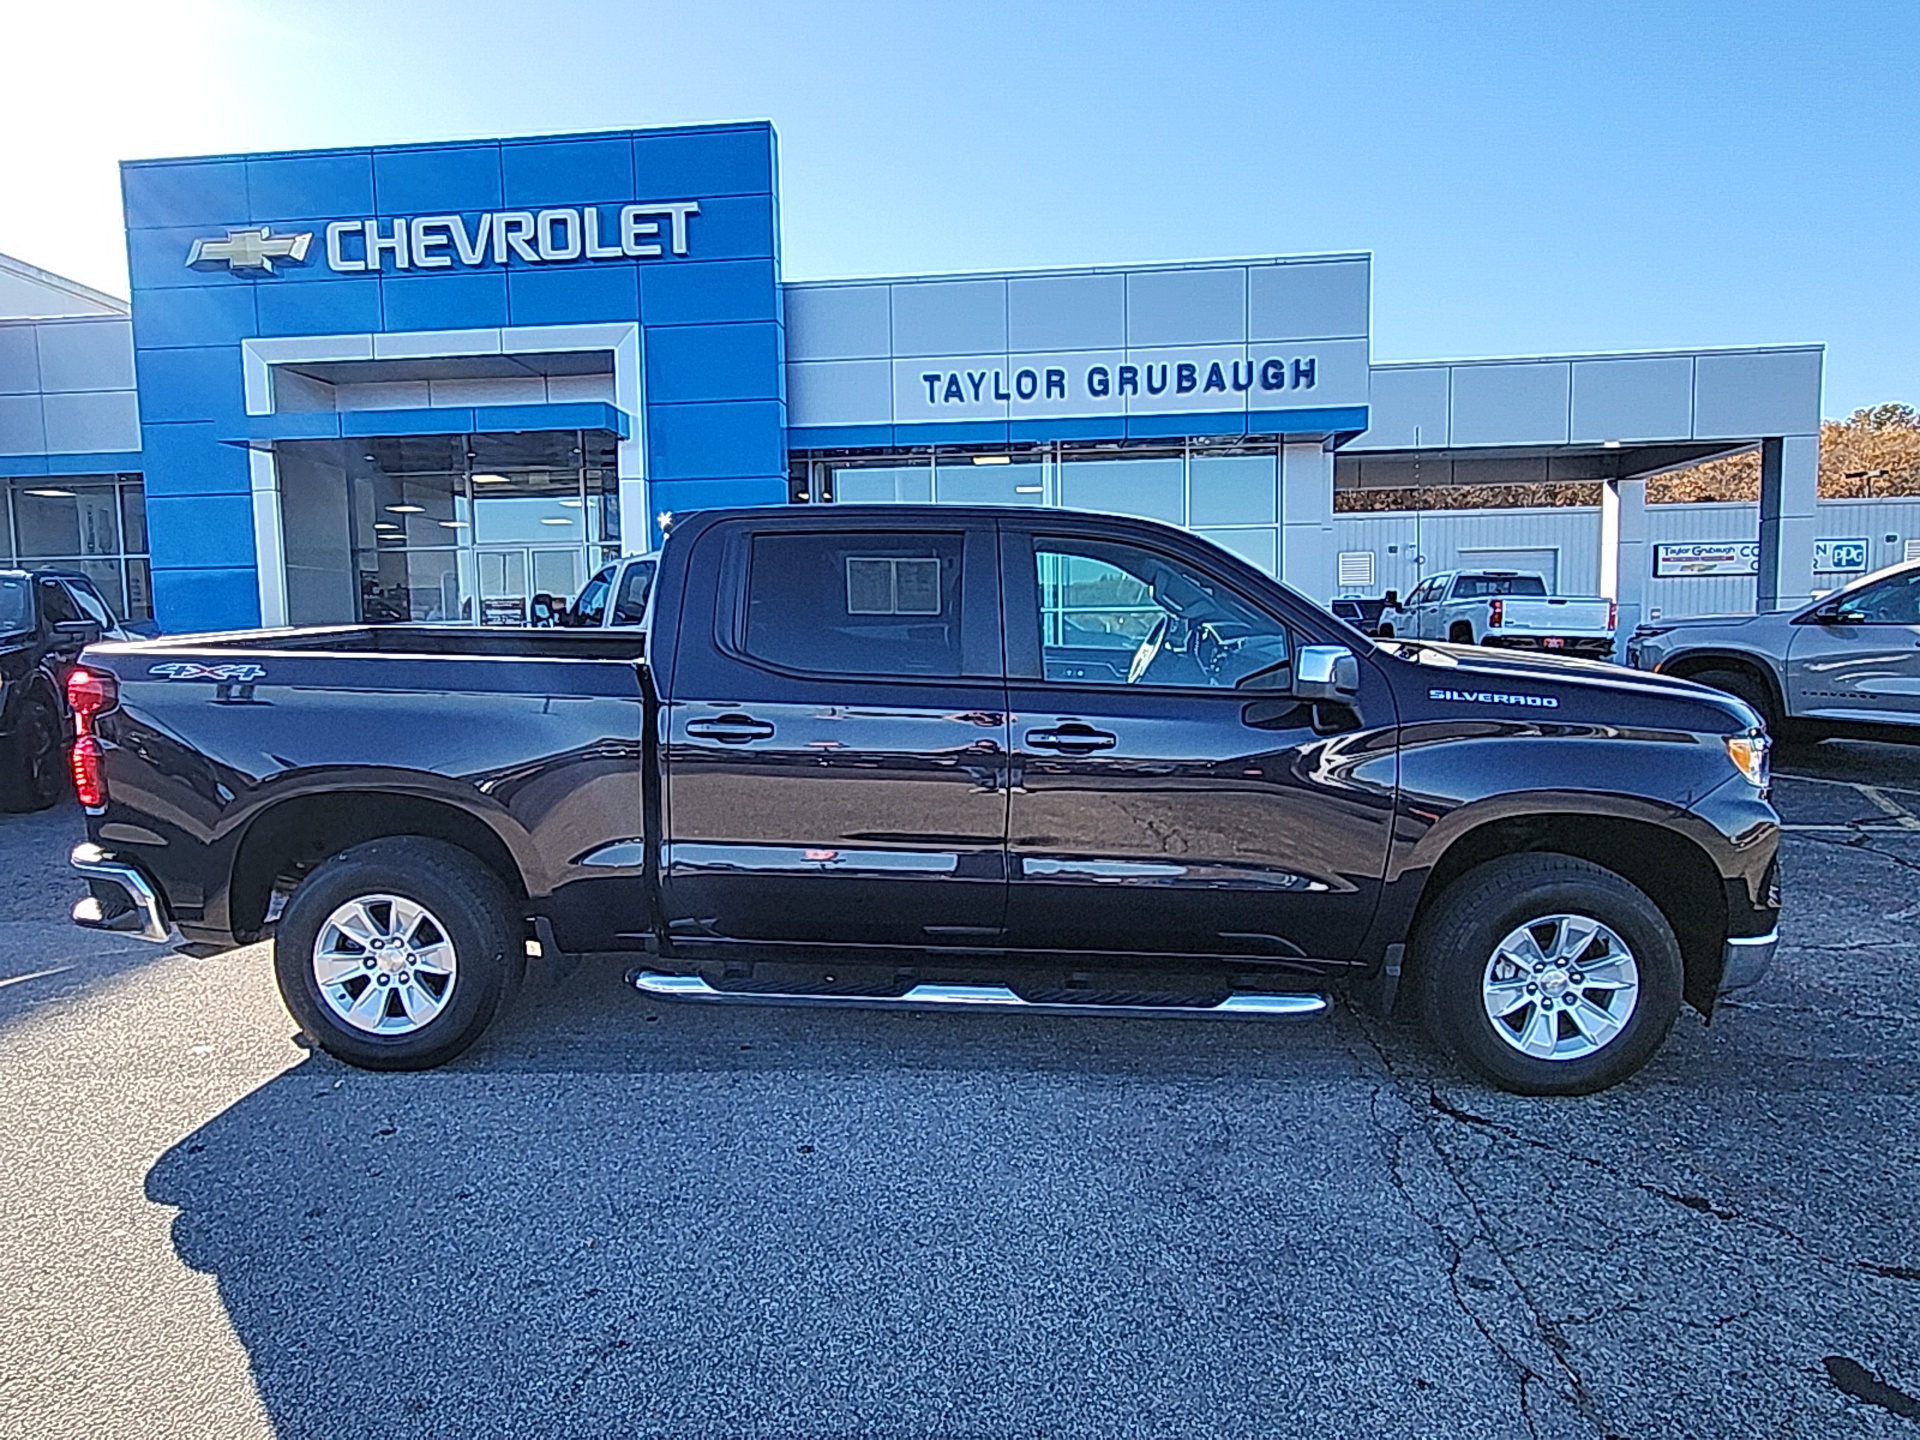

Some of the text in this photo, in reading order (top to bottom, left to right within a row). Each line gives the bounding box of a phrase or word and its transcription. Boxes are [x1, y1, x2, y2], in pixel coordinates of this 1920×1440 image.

[325, 201, 700, 273] CHEVROLET
[922, 358, 1317, 404] TAYLOR GRUBAUGH
[1834, 546, 1863, 566] PPG
[1429, 689, 1559, 708] SILVERADO
